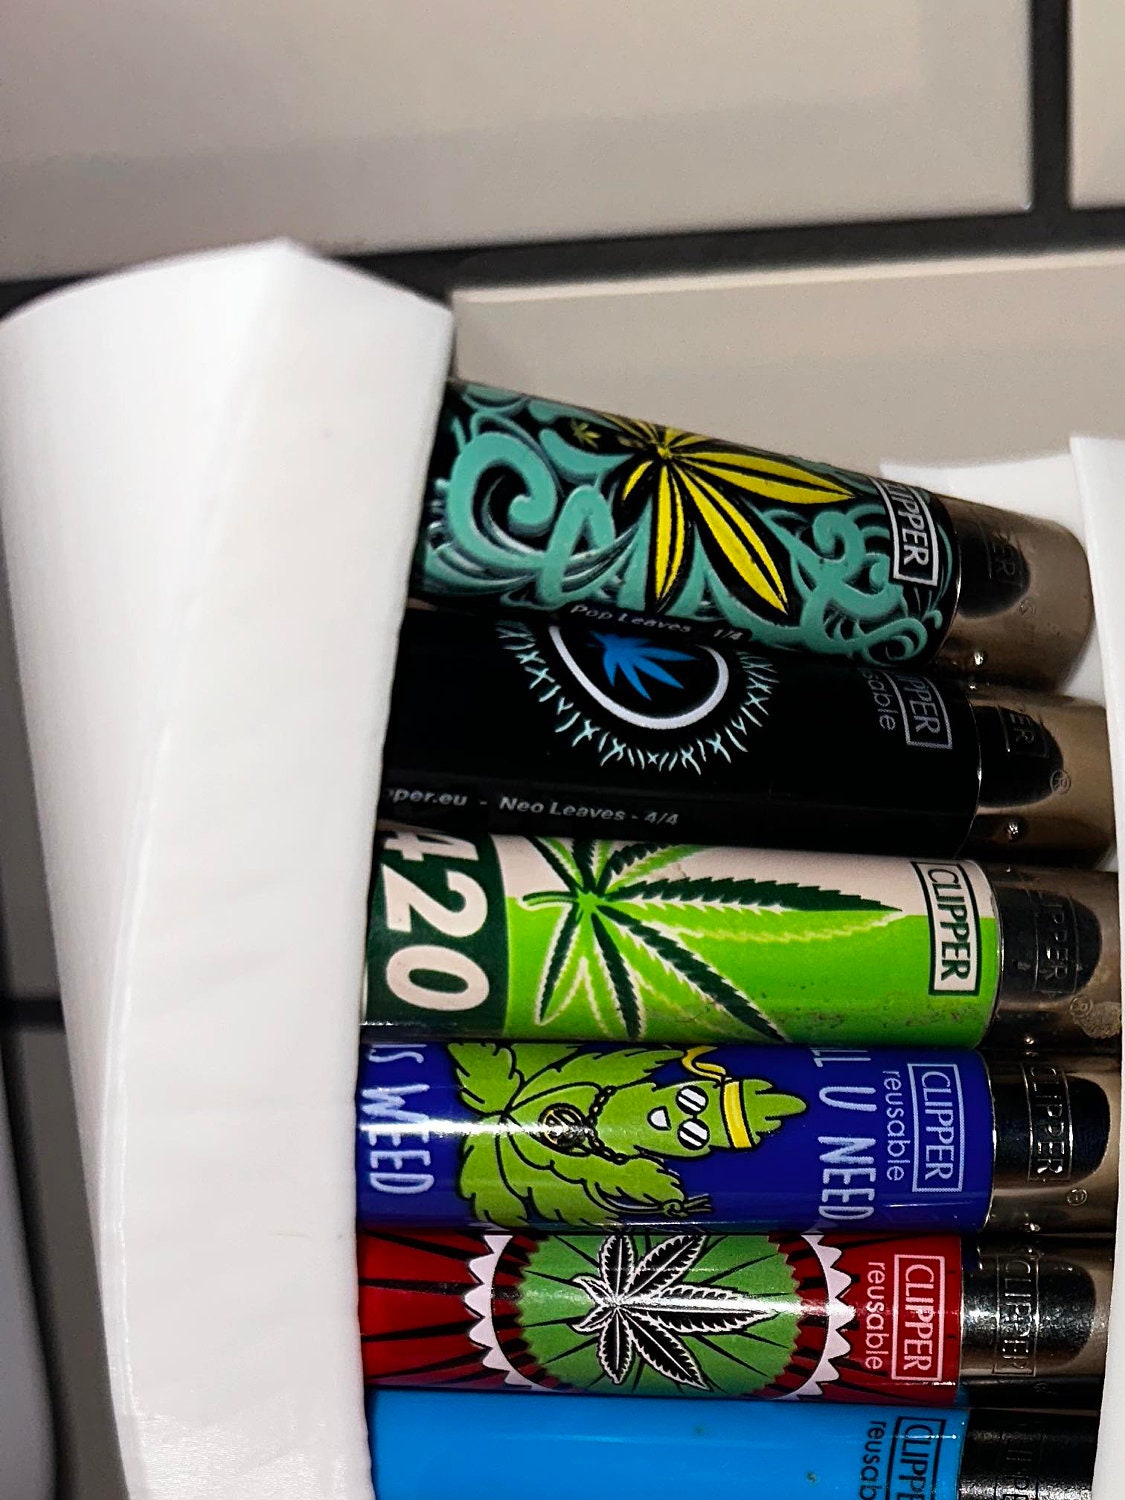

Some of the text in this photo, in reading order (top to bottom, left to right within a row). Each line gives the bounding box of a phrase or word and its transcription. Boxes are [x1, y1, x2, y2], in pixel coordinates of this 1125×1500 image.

[570, 603, 613, 620] Pop
[617, 612, 692, 634] Leaves
[499, 796, 544, 813] Neo
[549, 801, 626, 821] Leaves
[644, 811, 680, 827] 4/4
[382, 831, 490, 1012] 420
[927, 868, 971, 981] CLIPPER
[360, 1083, 435, 1194] WEED
[811, 1047, 878, 1220] LL U NEED
[882, 1069, 911, 1182] reusable
[921, 1070, 955, 1181] CLIPPER
[864, 1261, 890, 1370] reusable
[903, 1263, 935, 1372] CLIPPER
